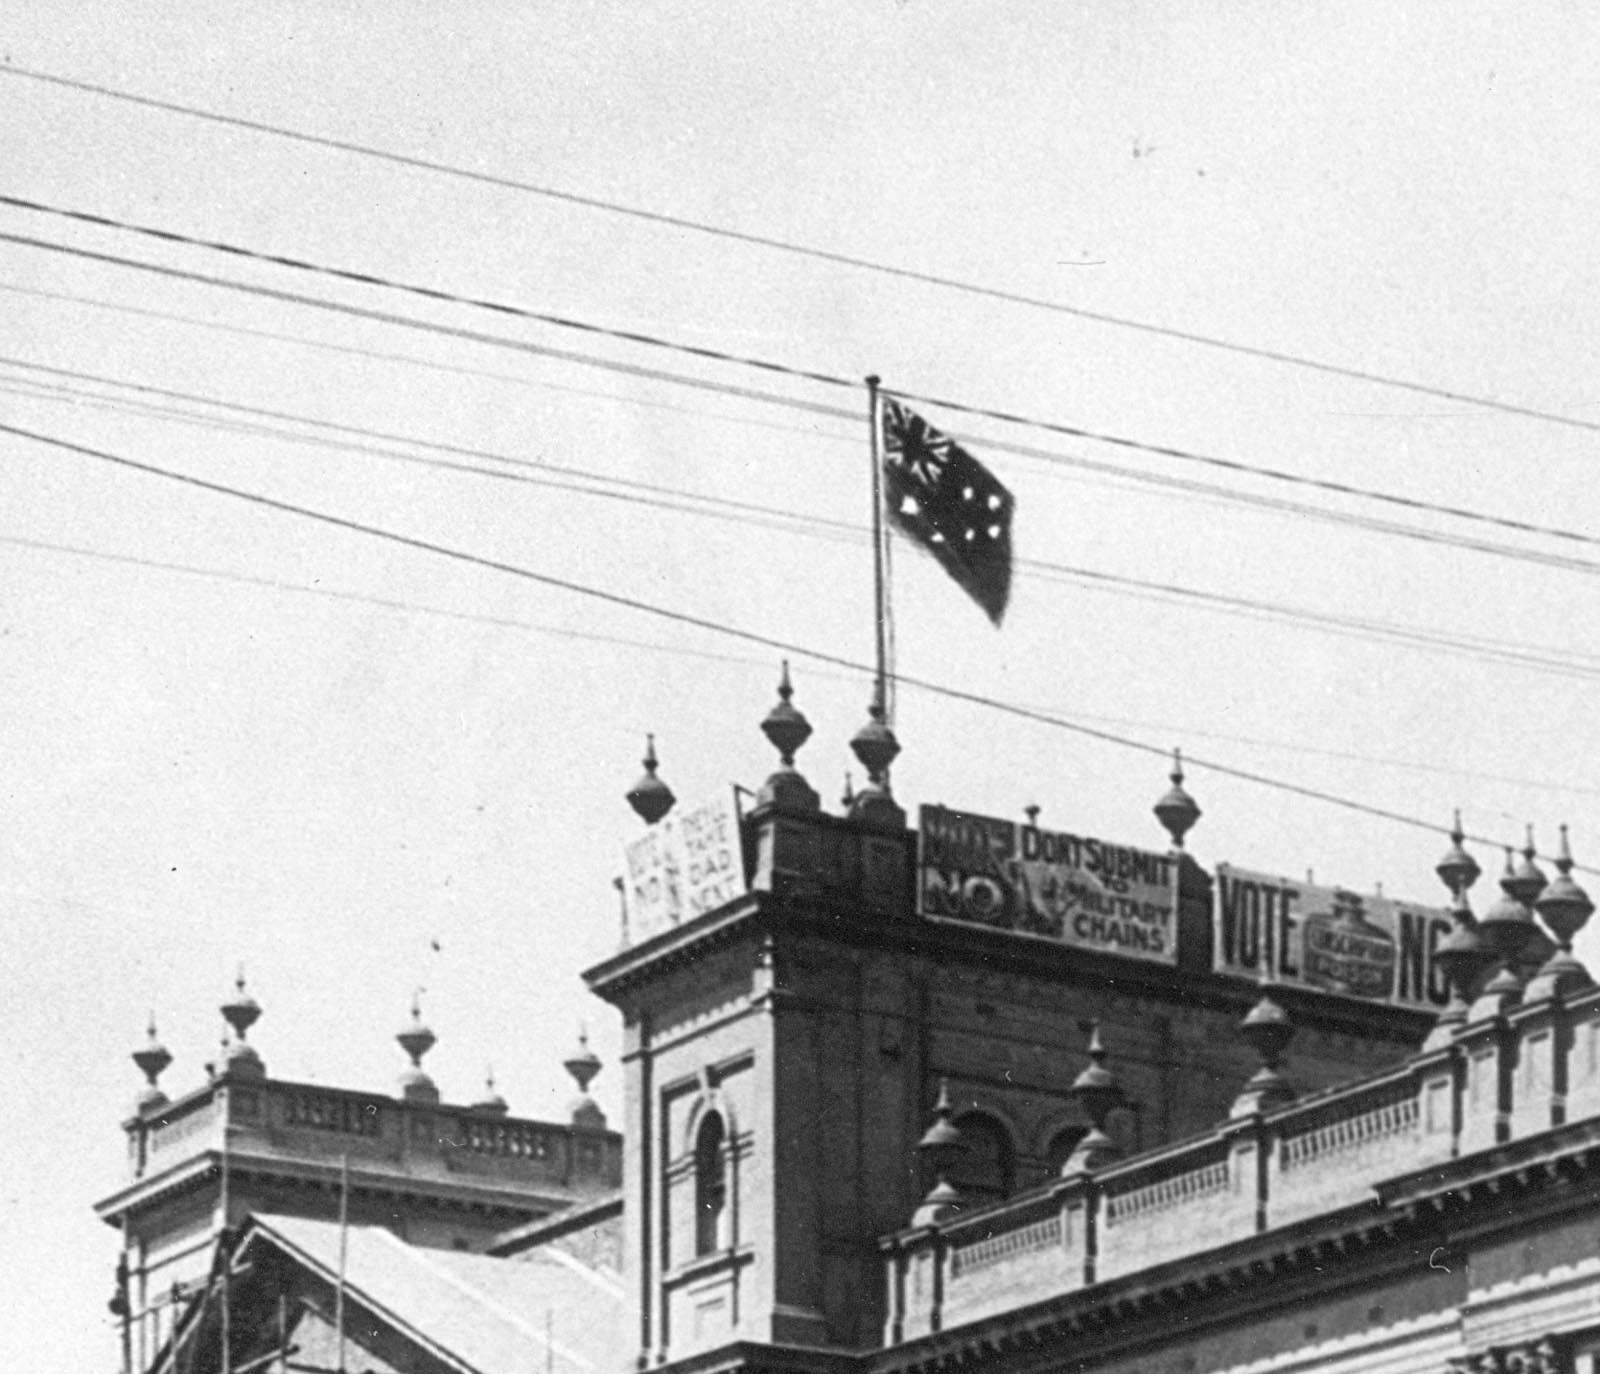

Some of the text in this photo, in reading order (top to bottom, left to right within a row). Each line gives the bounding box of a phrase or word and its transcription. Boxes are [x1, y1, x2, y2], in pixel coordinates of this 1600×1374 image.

[1083, 837, 1176, 887] SUBMIT
[1073, 911, 1164, 955] CHAINS
[1219, 873, 1297, 978] VOTE
